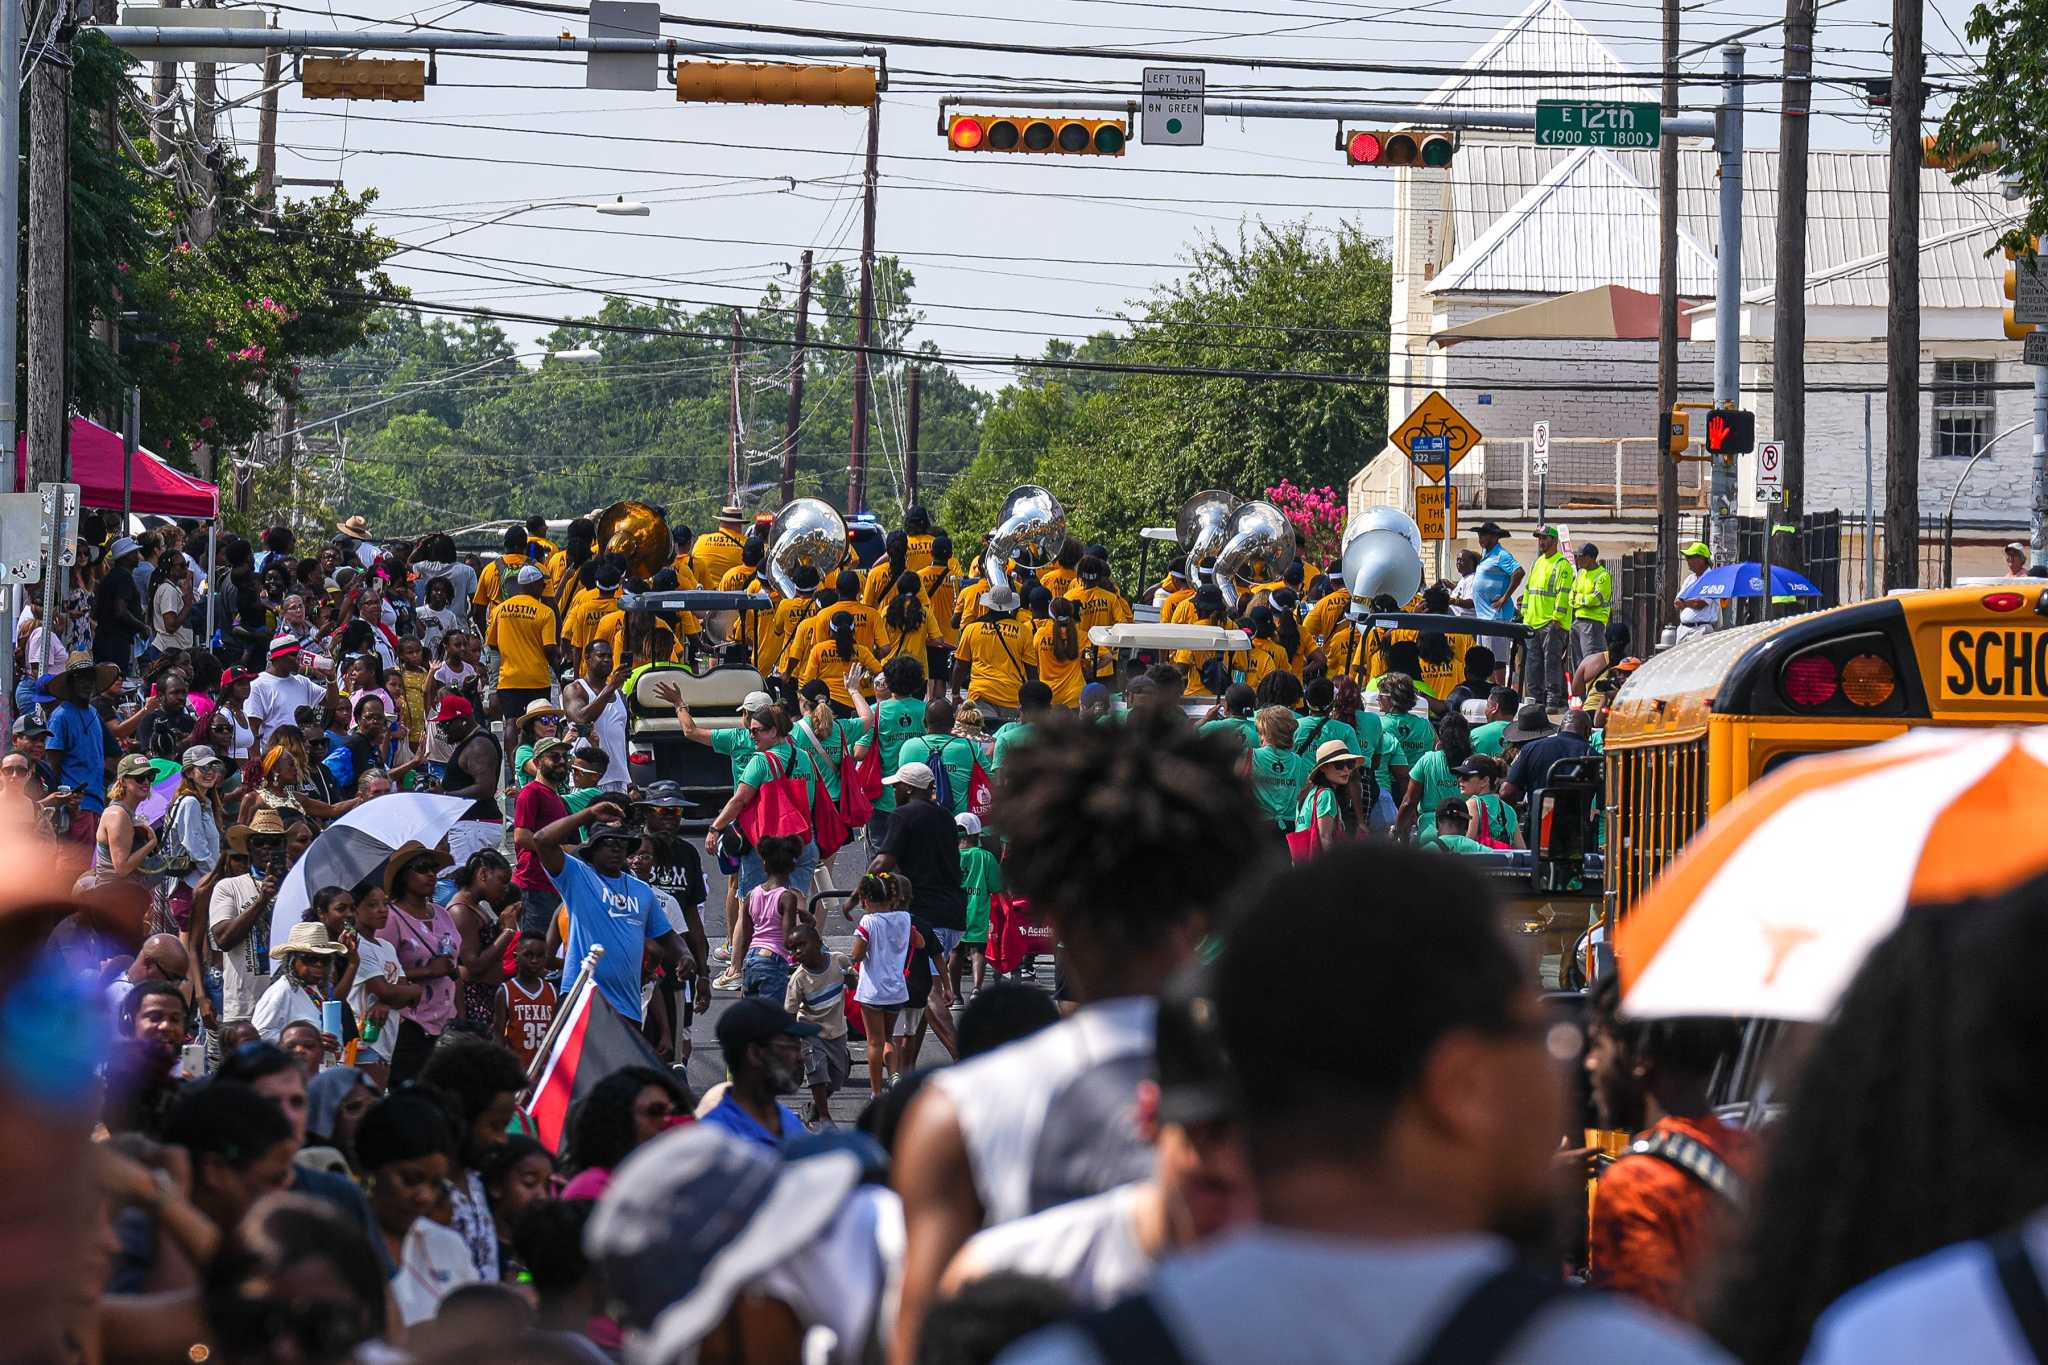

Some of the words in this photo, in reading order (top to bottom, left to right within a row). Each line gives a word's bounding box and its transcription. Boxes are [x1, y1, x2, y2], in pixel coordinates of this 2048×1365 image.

[1147, 74, 1170, 84] LEFT
[1176, 75, 1201, 85] TURN
[1148, 103, 1161, 113] ON
[1168, 104, 1199, 113] GREEN
[1562, 107, 1572, 122] E
[1580, 102, 1634, 129] 12th
[1552, 130, 1582, 143] 1900
[1590, 131, 1605, 144] ST
[1613, 132, 1643, 145] 1800
[1414, 453, 1429, 463] 322
[1423, 523, 1445, 534] ROA
[501, 604, 538, 615] AUSTIN
[1080, 599, 1108, 610] USTIN
[1424, 662, 1454, 673] USTIN
[514, 1004, 552, 1021] TEXAS
[523, 1022, 547, 1050] 35
